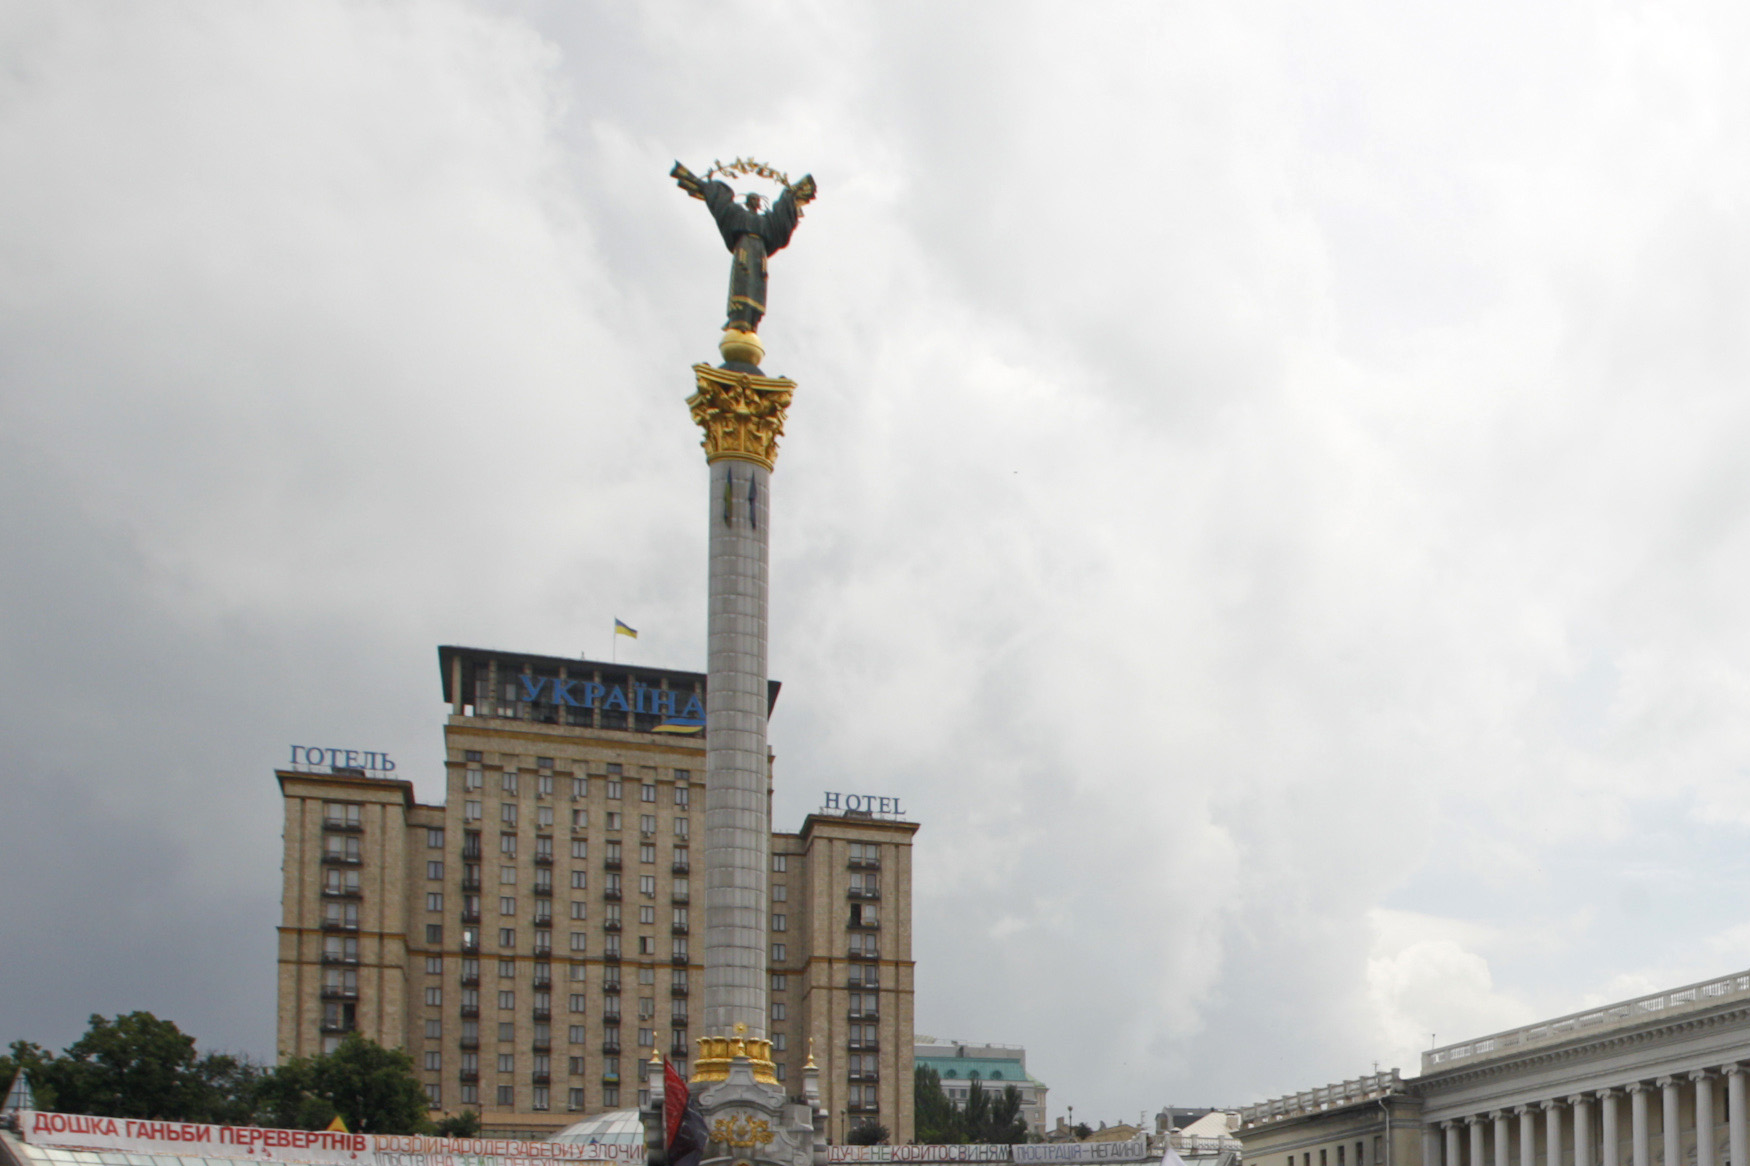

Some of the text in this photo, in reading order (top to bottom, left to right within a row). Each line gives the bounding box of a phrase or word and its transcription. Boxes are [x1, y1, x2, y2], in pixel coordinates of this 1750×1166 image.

[519, 673, 706, 719] УКРАЇНА
[289, 744, 396, 771] ГОТЕЛЬ
[824, 791, 906, 815] HOTEL
[33, 1112, 367, 1152] ДОШКА ГАНЬБИ ПЕРЕВЕРТНІВ
